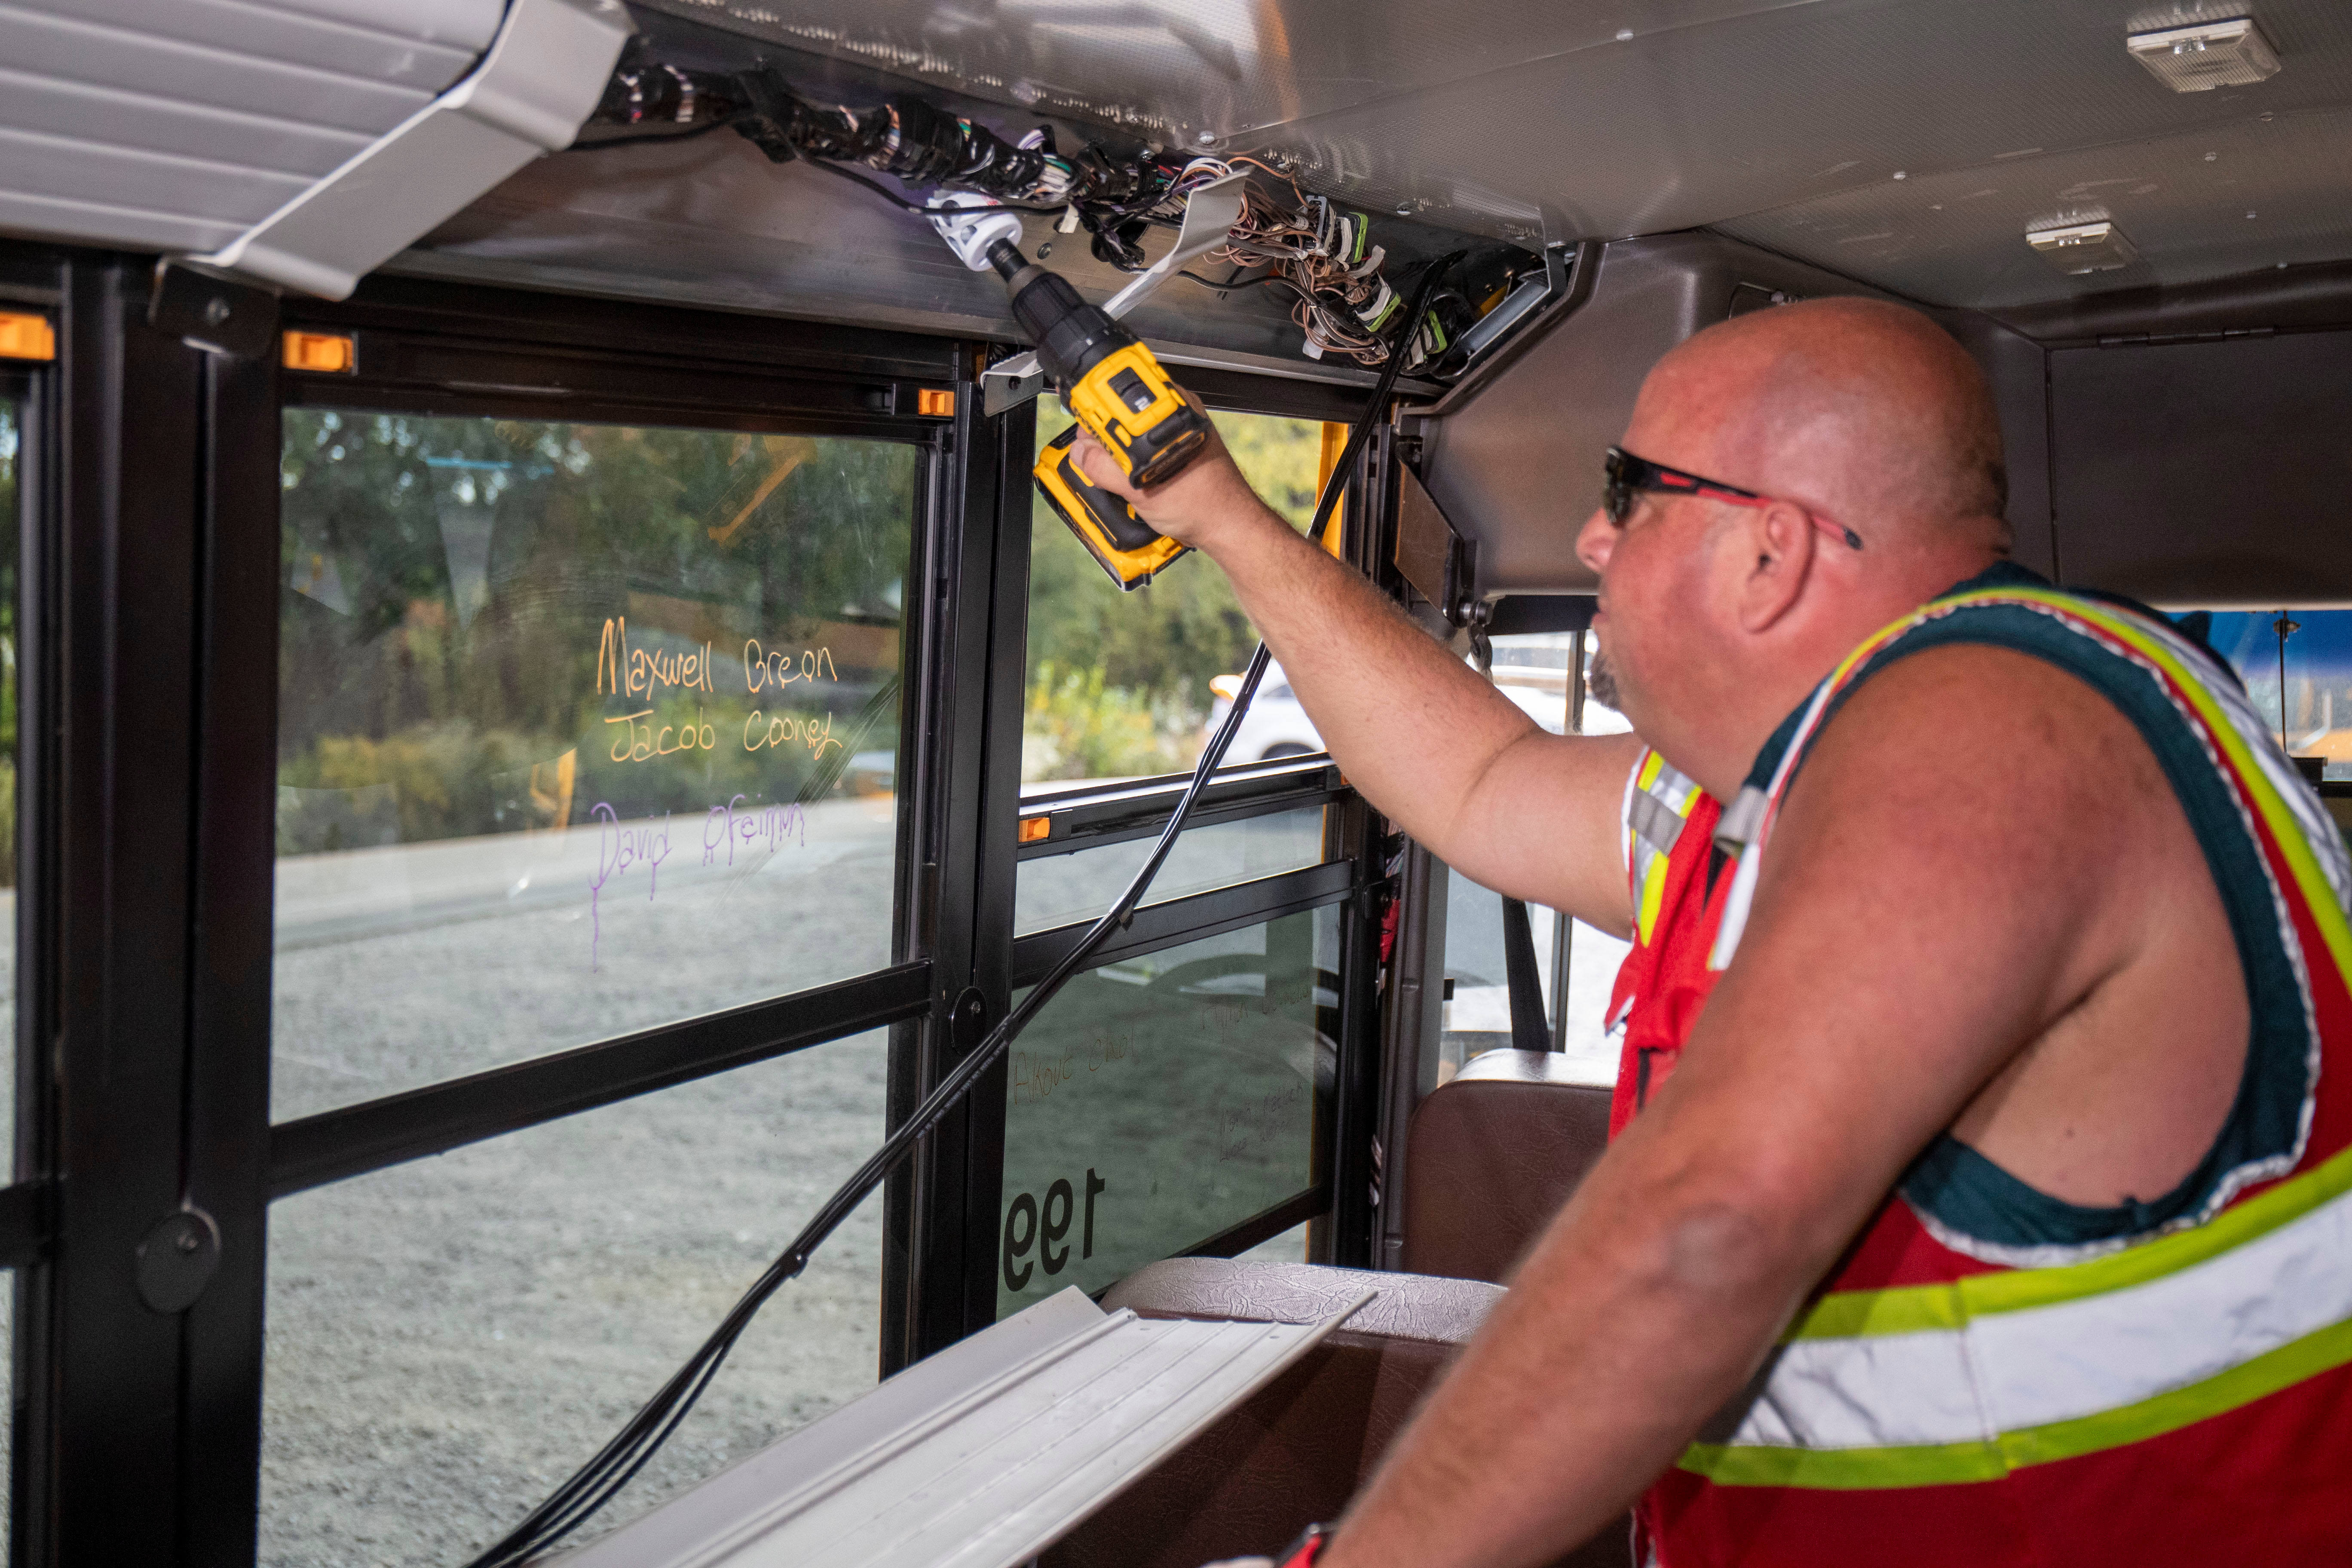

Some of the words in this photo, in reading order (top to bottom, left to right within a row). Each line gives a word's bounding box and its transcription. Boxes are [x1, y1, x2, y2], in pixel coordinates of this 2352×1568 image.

[597, 616, 714, 701] Maxwell
[604, 707, 715, 762] Jacob
[744, 710, 843, 761] Cooney
[588, 802, 673, 916] David
